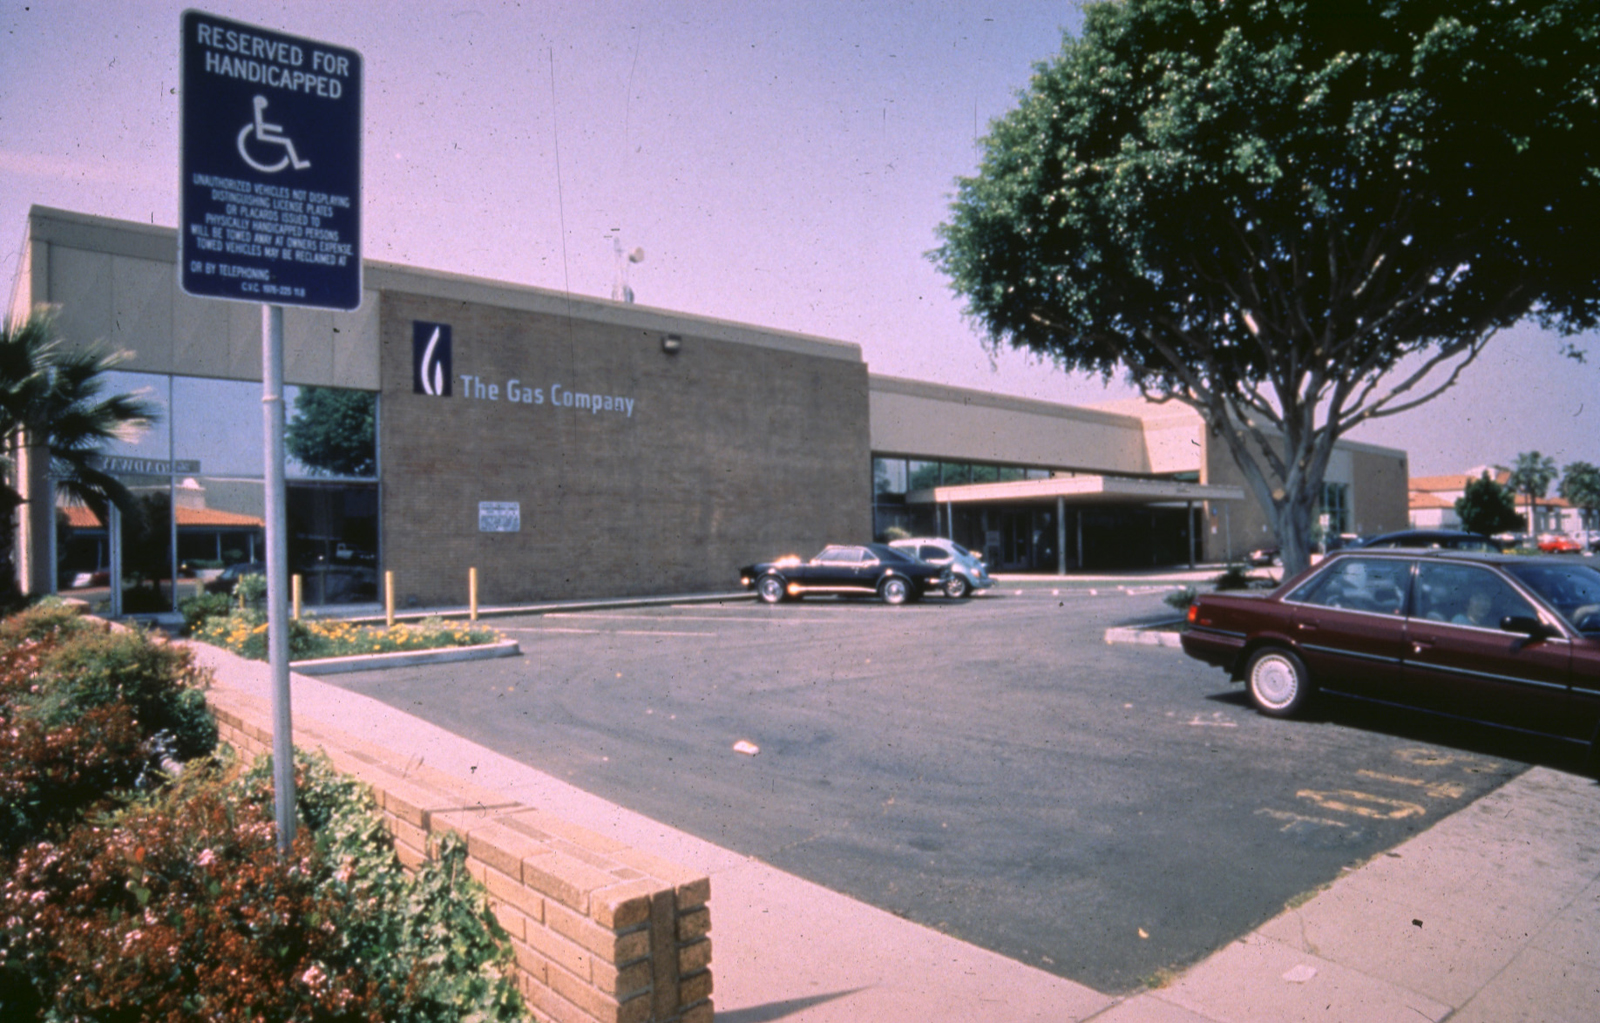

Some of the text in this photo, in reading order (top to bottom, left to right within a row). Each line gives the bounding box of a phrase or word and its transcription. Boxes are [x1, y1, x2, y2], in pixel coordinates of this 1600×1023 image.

[197, 23, 349, 77] RESERVED FOR
[206, 51, 342, 99] HANDICAPPED
[254, 183, 289, 199] VEHICLES
[292, 190, 306, 200] NOT
[309, 192, 350, 208] DISPLAYING
[272, 200, 304, 213] LICENSE
[306, 203, 333, 217] PLATES
[205, 213, 339, 241] PHYSICALLY HANDICAPPED PERSONS
[226, 204, 320, 227] OR PLACARDS ISSUED TO
[191, 224, 209, 237] WILL
[212, 226, 223, 238] BE
[226, 229, 251, 242] TOWED
[254, 233, 272, 245] AWAY
[275, 236, 284, 246] AT
[197, 237, 347, 266] TOWED VEHICLES MAY BE RECLAIMED AT
[190, 261, 270, 281] OR BY TELEPHONING
[460, 374, 634, 418] The Gas Company
